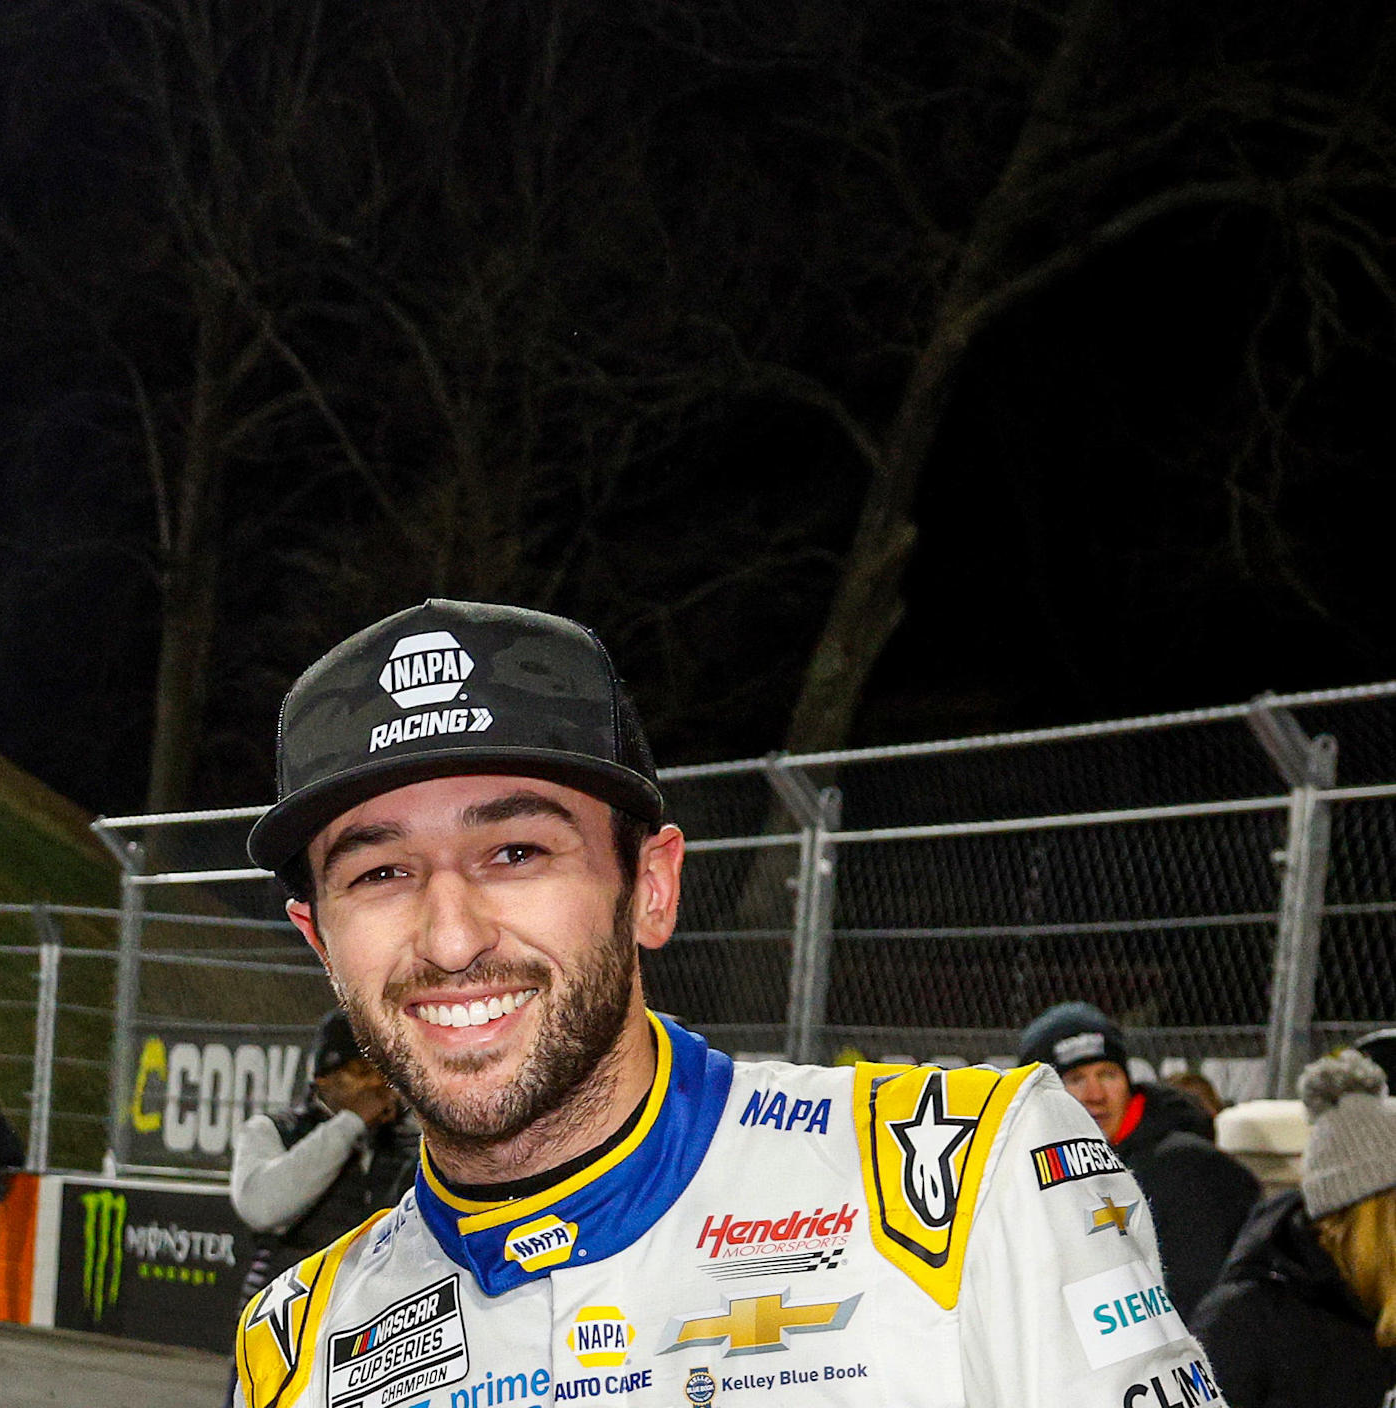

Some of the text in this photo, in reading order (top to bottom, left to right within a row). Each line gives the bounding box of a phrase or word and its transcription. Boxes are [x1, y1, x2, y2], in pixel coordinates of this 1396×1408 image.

[393, 650, 461, 691] NAPA
[369, 708, 469, 753] RACING
[739, 1088, 832, 1135] NAPA
[513, 1225, 570, 1258] NAPA
[696, 1203, 859, 1258] Hendrick
[723, 1235, 848, 1258] MOTORSPORTS
[373, 1293, 440, 1346] NASCAR
[578, 1323, 625, 1351] NAPA
[348, 1328, 444, 1388] CUP SERIES
[722, 1364, 867, 1392] Kelley Blue Book
[381, 1366, 448, 1405] CHAMPION
[554, 1369, 652, 1402] AUTO CARE
